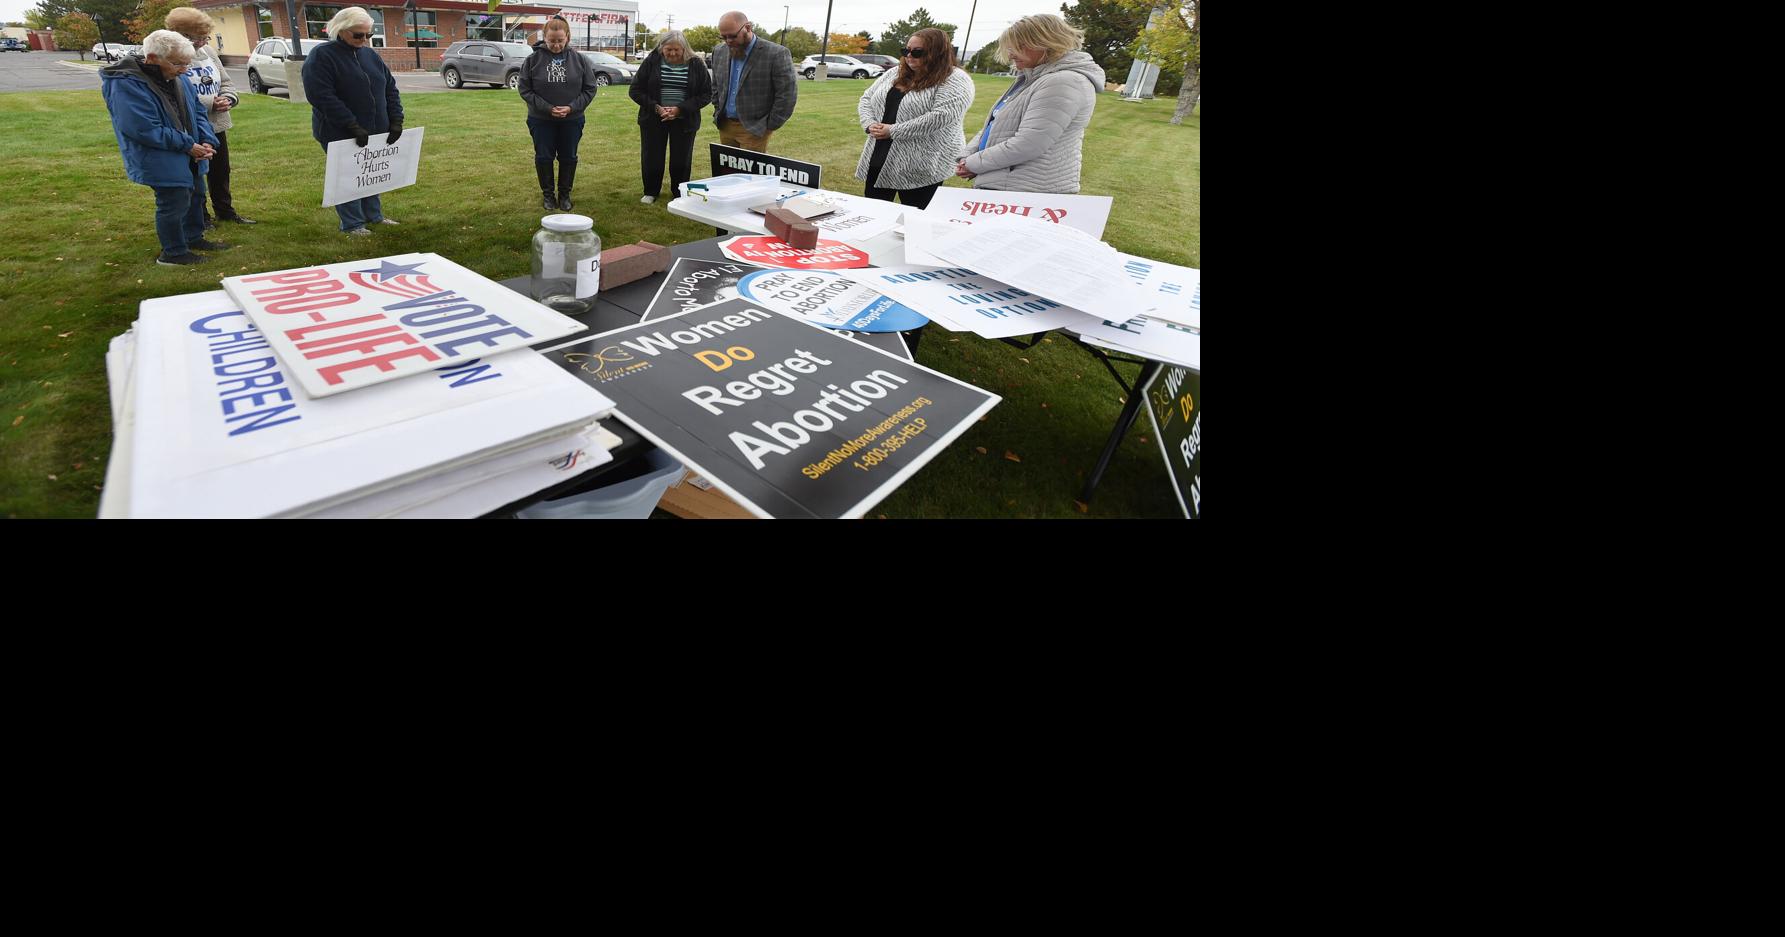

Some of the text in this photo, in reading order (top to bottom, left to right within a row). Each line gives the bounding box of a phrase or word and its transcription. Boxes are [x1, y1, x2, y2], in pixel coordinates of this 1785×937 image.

[185, 65, 214, 77] STOP
[353, 144, 399, 164] Abortion
[361, 160, 390, 175] Hurts
[355, 172, 392, 189] Women
[719, 153, 810, 185] PRAY TO END
[1040, 207, 1067, 224] &
[796, 253, 862, 265] STOP
[674, 268, 721, 297] Aborto
[754, 272, 796, 292] PRAY
[769, 276, 825, 302] TO END
[880, 267, 980, 284] ADOPTIO
[946, 281, 983, 292] THE
[790, 278, 857, 316] ABORTION
[947, 286, 1031, 306] LOVING
[975, 298, 1062, 320] OPTION
[240, 268, 443, 386] PRO-LIFE
[381, 289, 534, 358] VOTE
[620, 308, 773, 358] Women
[693, 345, 756, 373] Do
[188, 310, 302, 437] CHILDREN
[681, 348, 833, 417] Regret
[727, 368, 909, 471] Abortion
[1180, 392, 1194, 423] Do
[801, 396, 933, 481] SilentNoMoreAwareness.org
[852, 416, 929, 473] 1-800-395-HELP
[1180, 410, 1200, 469] Reg
